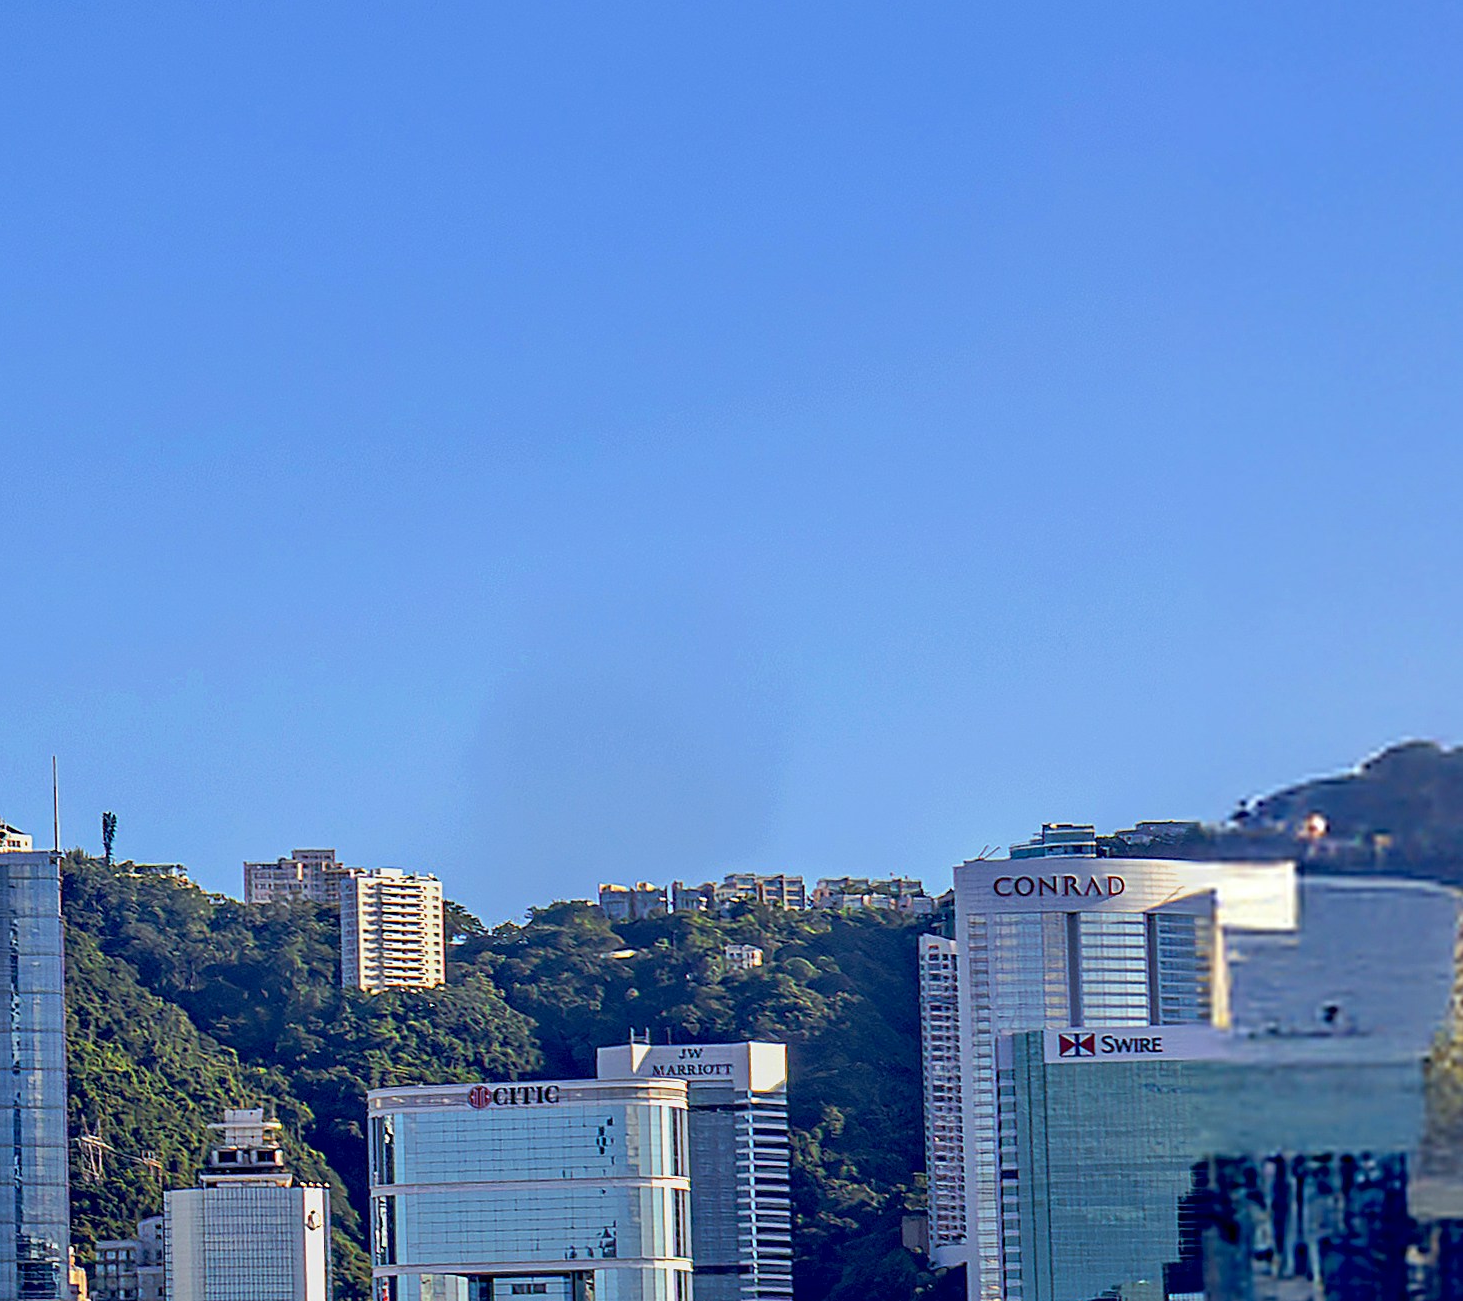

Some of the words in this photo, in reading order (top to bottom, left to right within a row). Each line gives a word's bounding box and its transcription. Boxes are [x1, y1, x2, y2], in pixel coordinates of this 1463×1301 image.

[994, 876, 1125, 896] CONRAD
[679, 1048, 703, 1059] JW
[653, 1064, 734, 1076] MARRIOTT
[493, 1085, 560, 1105] CITIC
